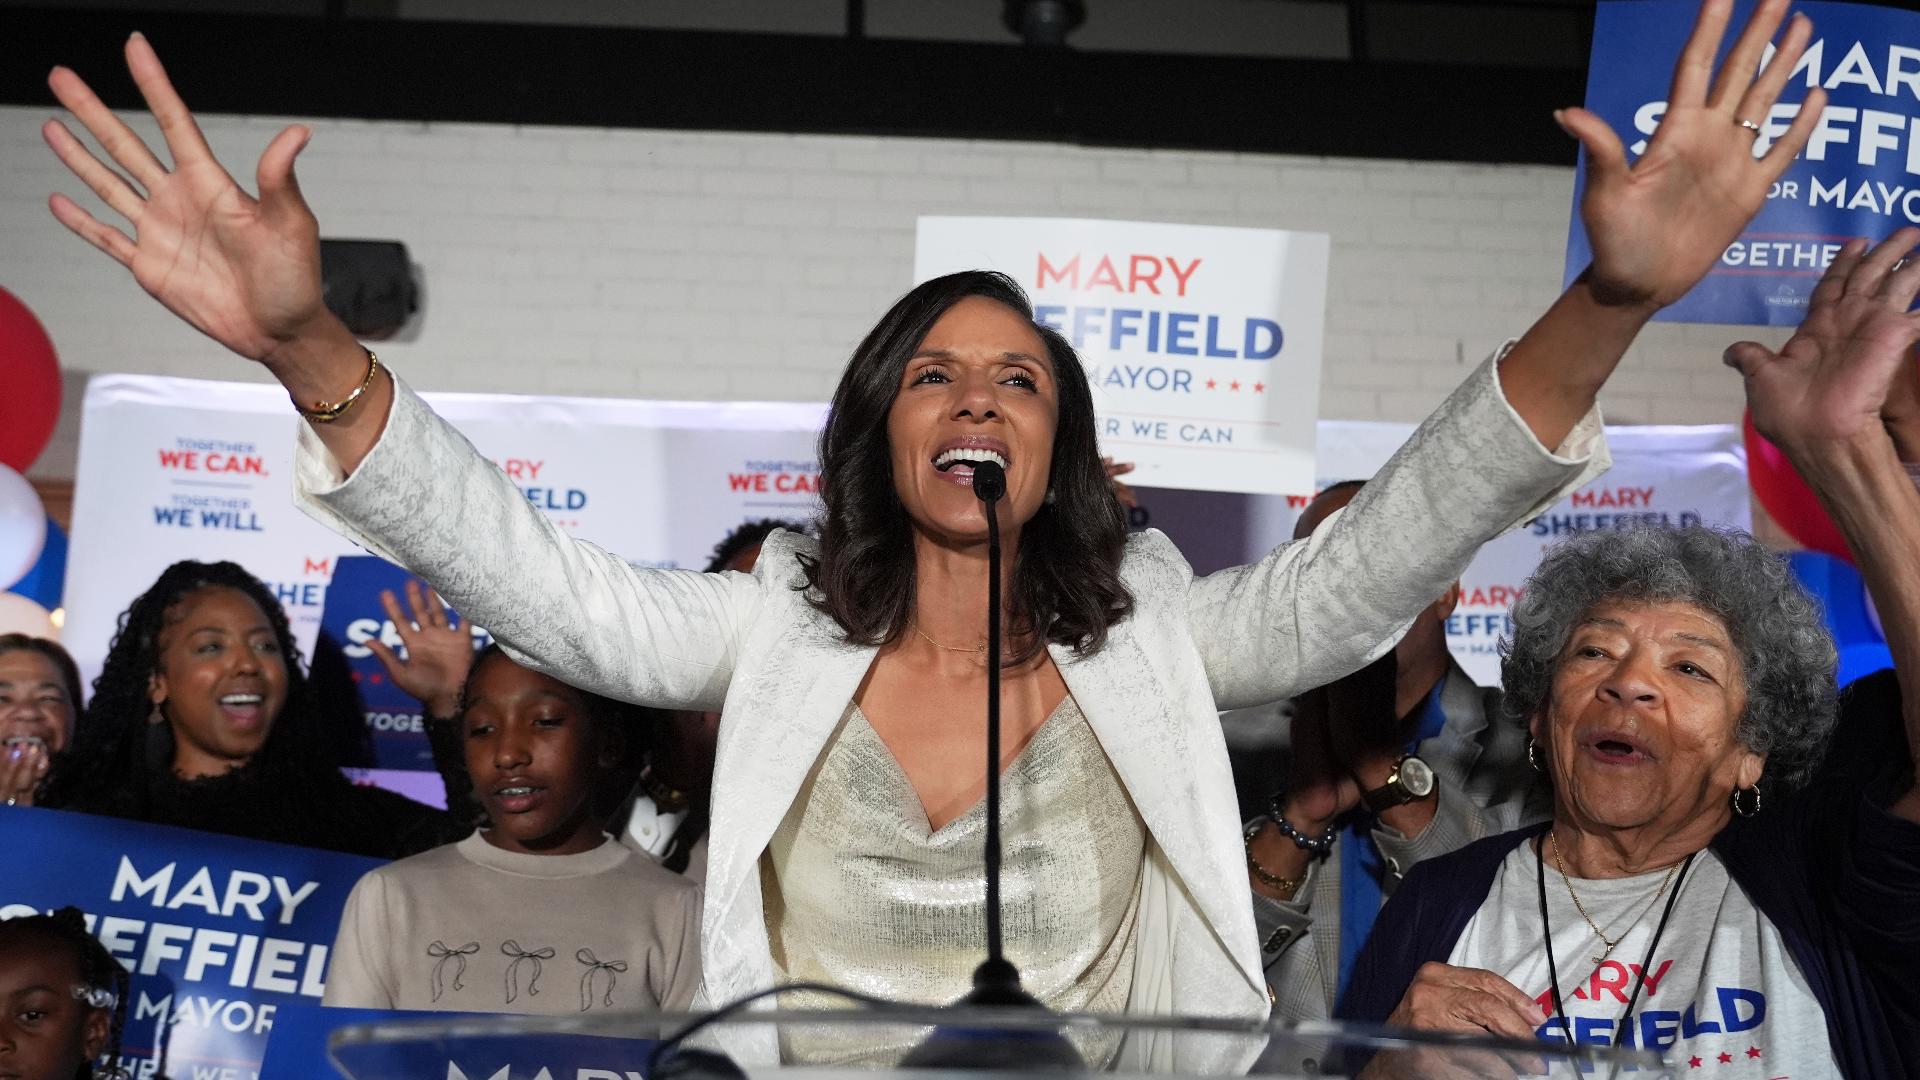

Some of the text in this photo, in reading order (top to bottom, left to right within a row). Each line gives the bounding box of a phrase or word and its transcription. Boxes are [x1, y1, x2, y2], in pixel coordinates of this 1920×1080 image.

[1766, 181, 1799, 200] OR
[1721, 241, 1842, 268] GETHE
[1035, 252, 1203, 297] MARY
[1034, 305, 1285, 361] EFFIELD
[1094, 365, 1193, 393] AYOR
[1132, 420, 1169, 441] WE
[1179, 423, 1234, 444] CAN
[158, 449, 269, 476] WE CAN.
[505, 458, 545, 479] RY
[728, 472, 768, 493] WE
[521, 486, 587, 511] ELD
[1570, 485, 1655, 509] MARY
[153, 506, 264, 531] WE WILL
[364, 712, 425, 733] TOGE
[110, 854, 321, 925] MARY
